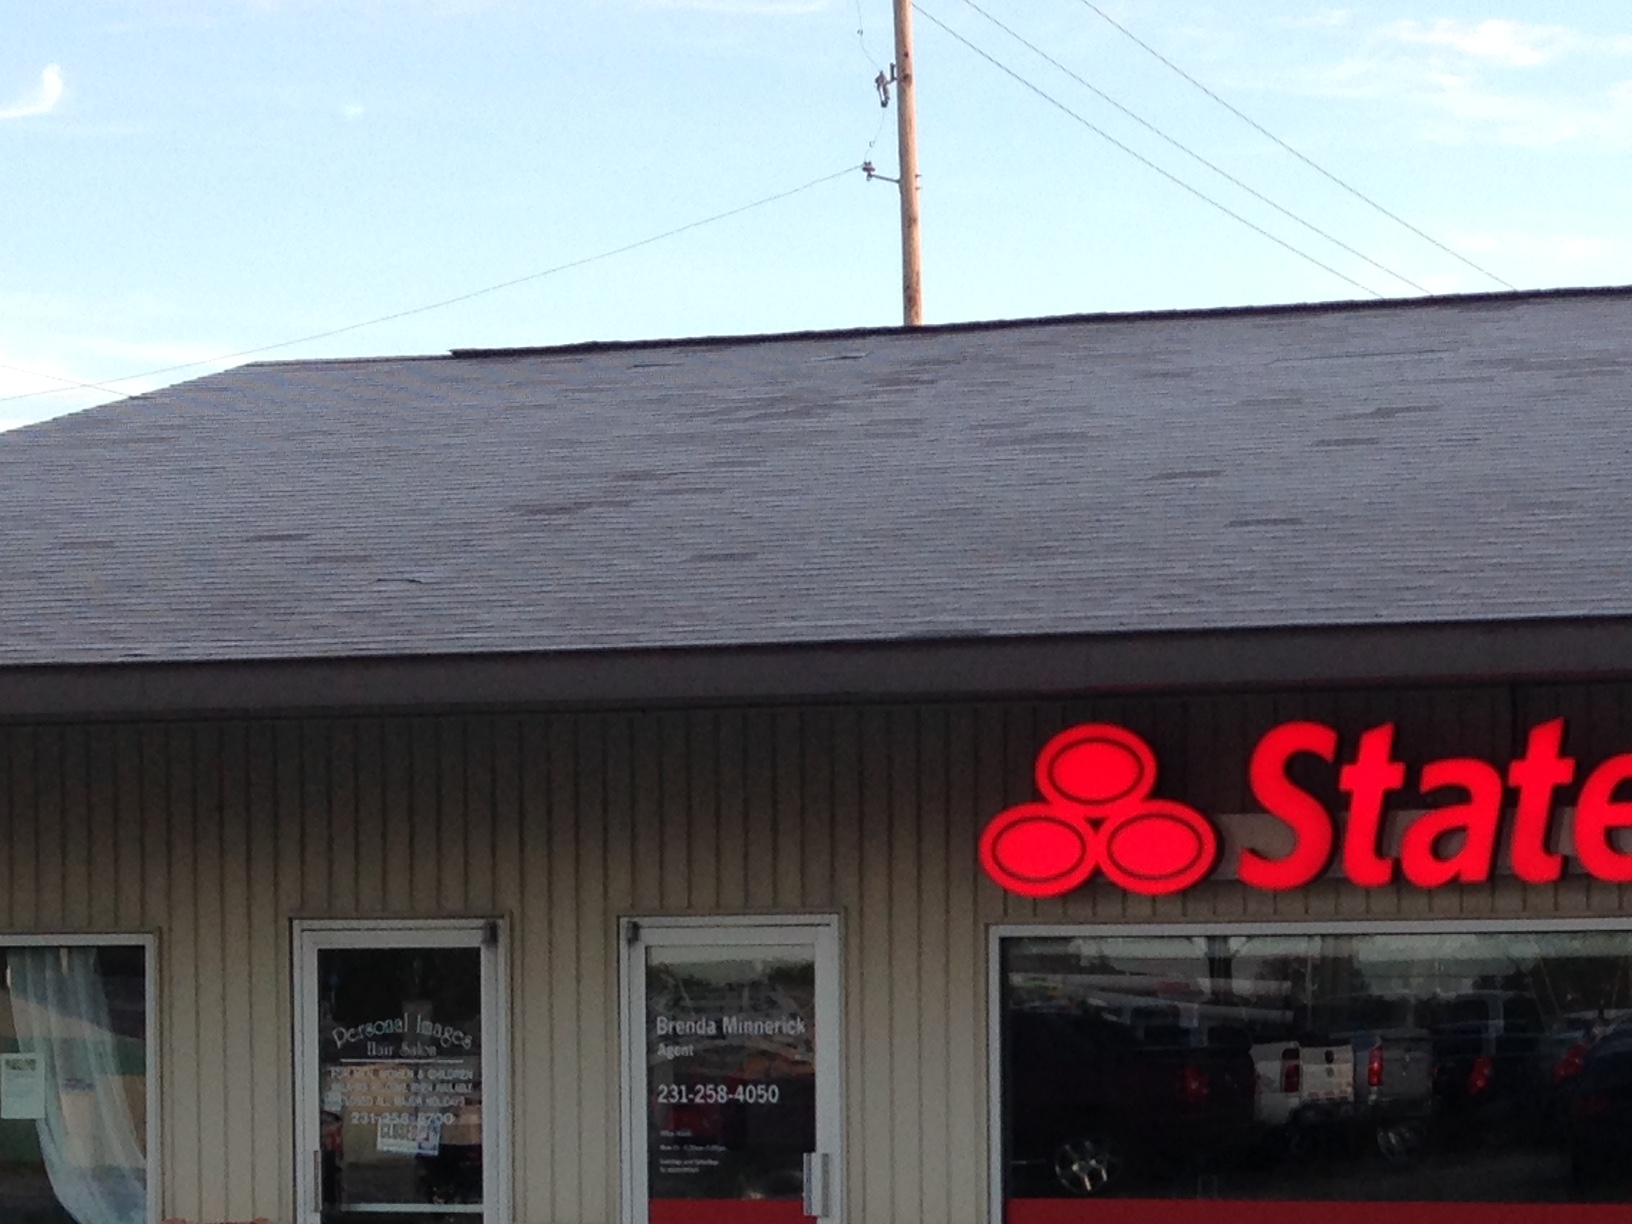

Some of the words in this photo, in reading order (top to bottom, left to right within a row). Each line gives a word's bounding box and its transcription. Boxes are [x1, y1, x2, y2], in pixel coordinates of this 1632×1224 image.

[332, 1012, 408, 1049] Personal
[415, 1013, 473, 1049] Images
[656, 1016, 716, 1035] Brenda
[722, 1016, 805, 1035] Minnerick
[367, 1041, 394, 1056] Hair
[399, 1041, 437, 1057] Salon
[657, 1043, 694, 1059] Agent
[657, 1083, 780, 1103] 231-258-4050
